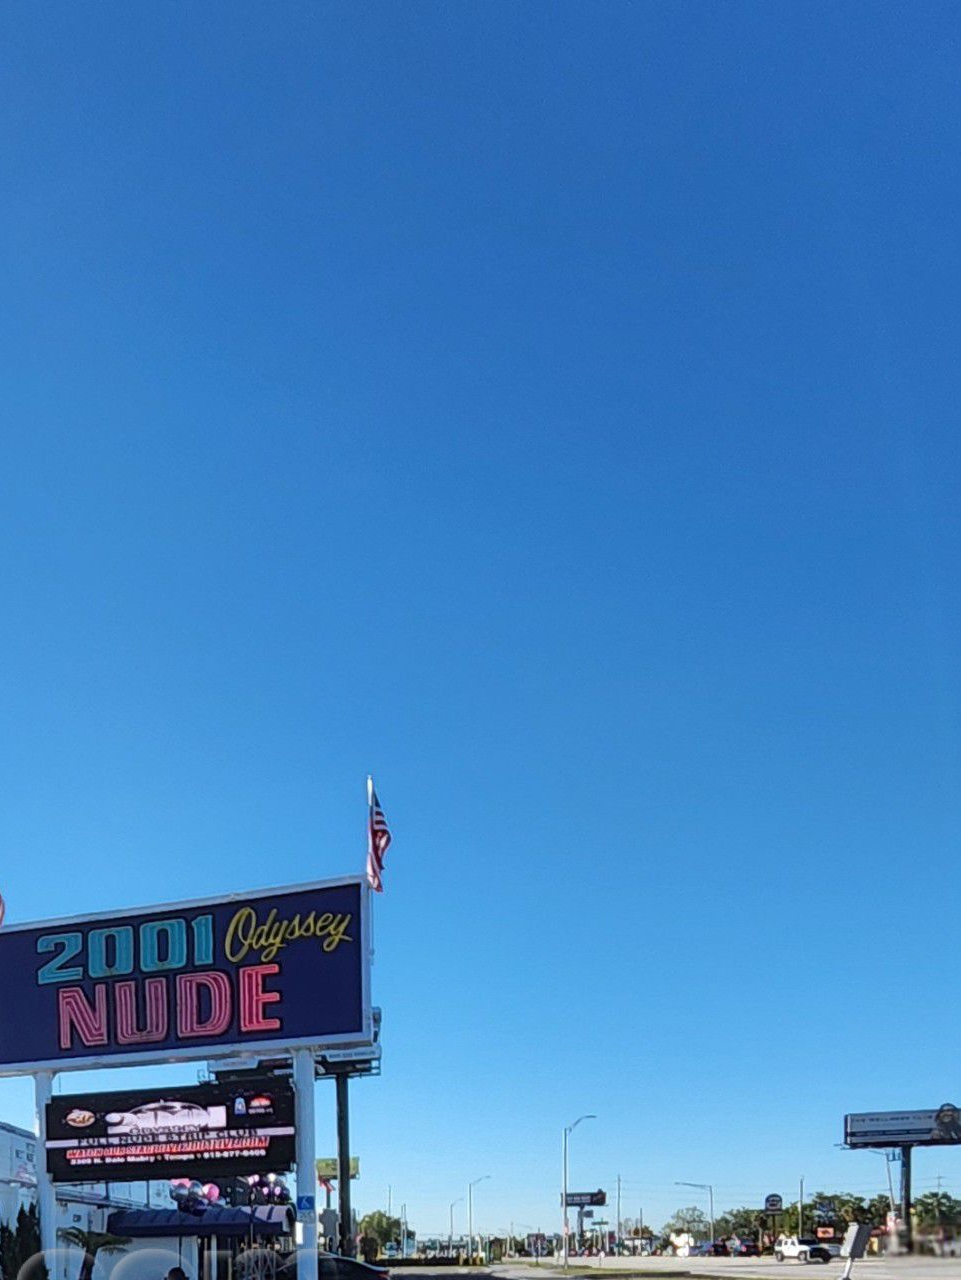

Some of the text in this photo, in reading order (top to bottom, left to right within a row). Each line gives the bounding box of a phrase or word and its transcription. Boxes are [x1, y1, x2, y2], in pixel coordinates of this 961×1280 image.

[36, 906, 353, 985] 2001 Odyssey
[58, 964, 282, 1050] NUDE
